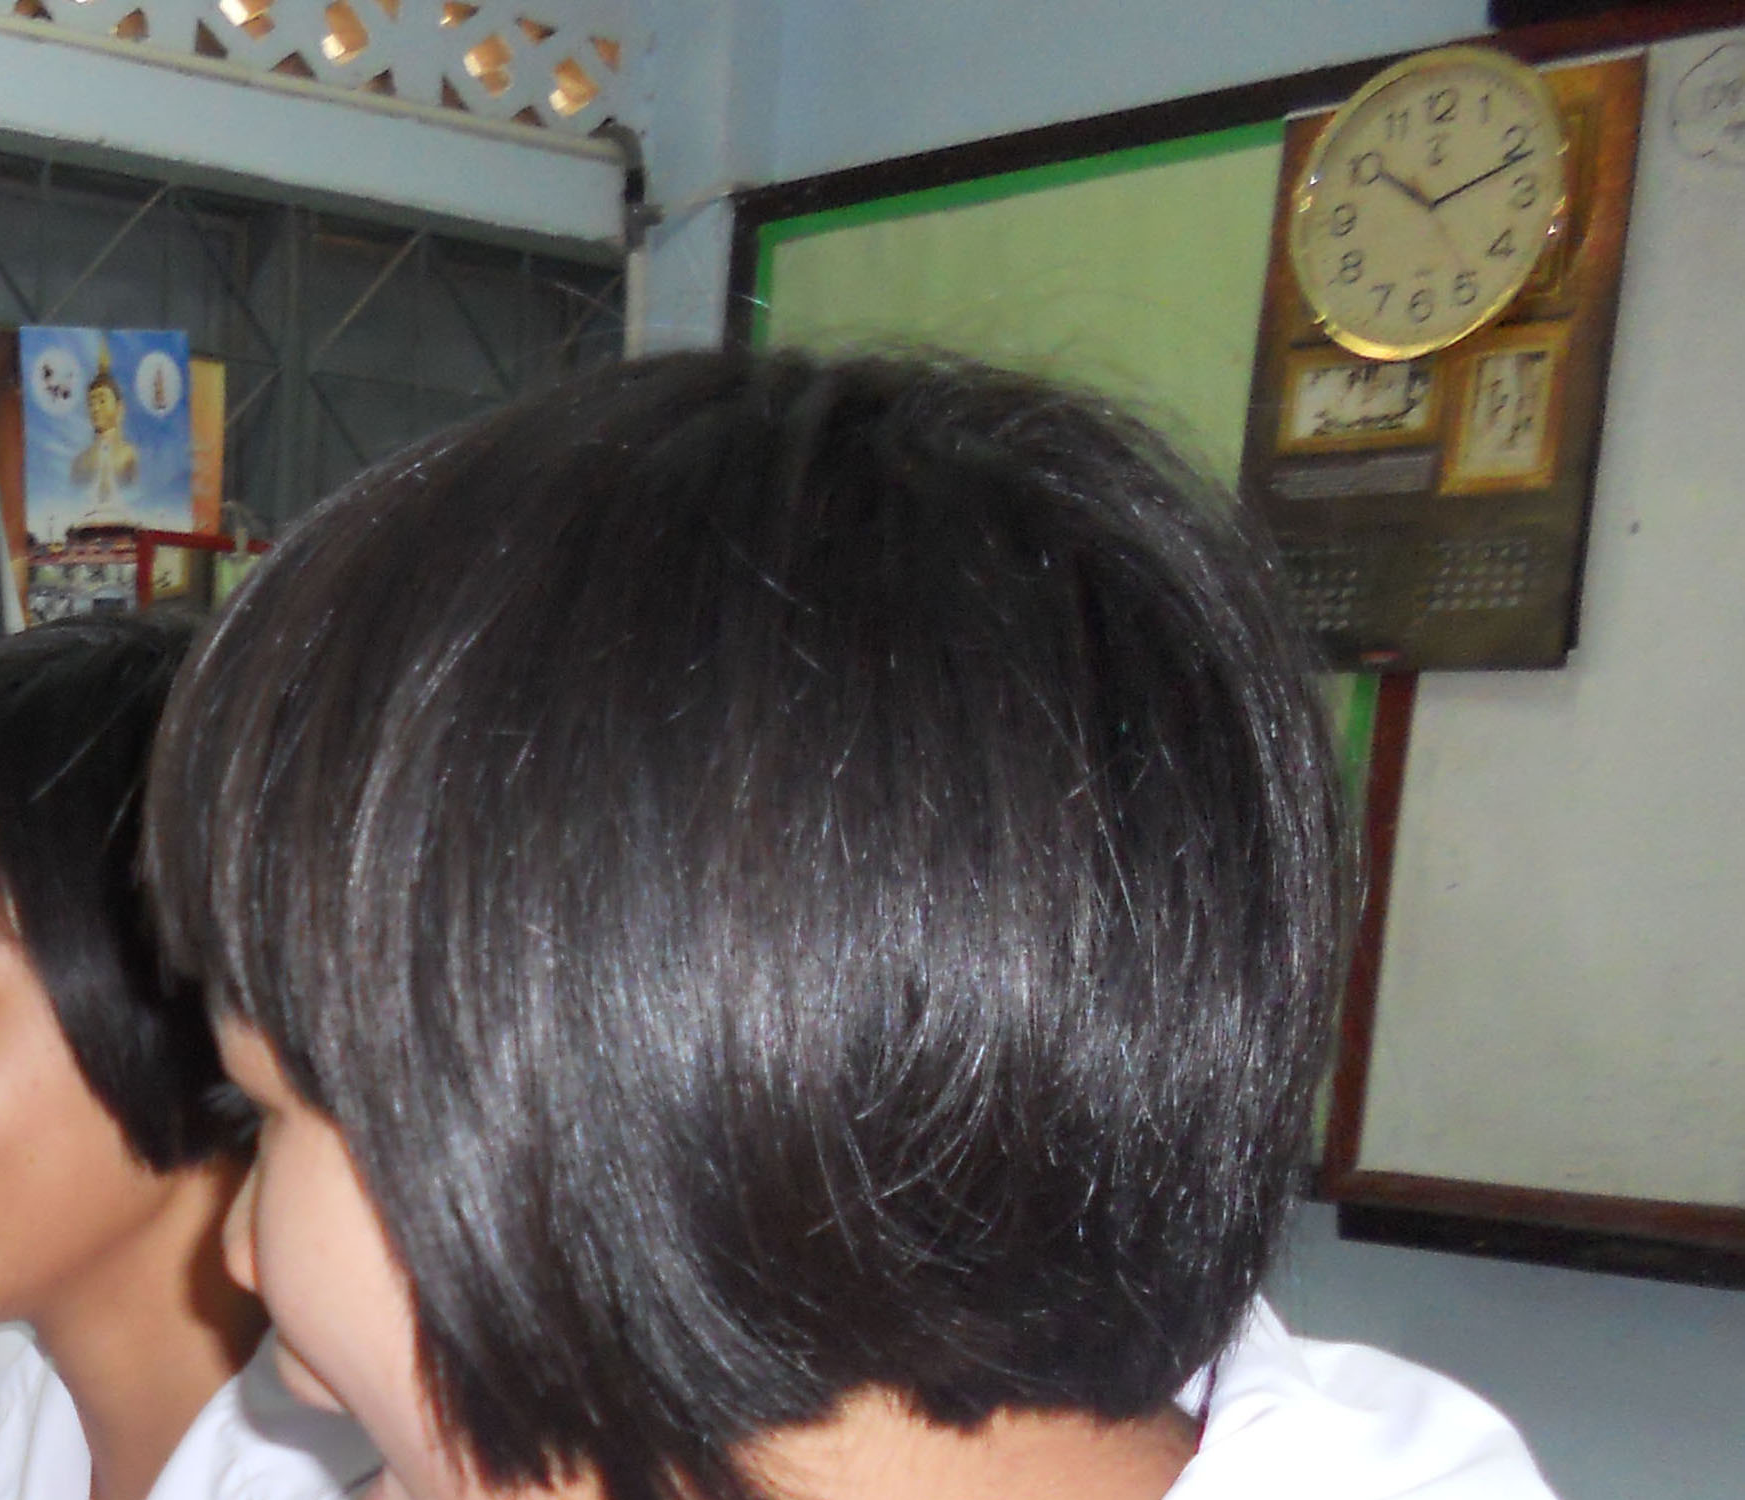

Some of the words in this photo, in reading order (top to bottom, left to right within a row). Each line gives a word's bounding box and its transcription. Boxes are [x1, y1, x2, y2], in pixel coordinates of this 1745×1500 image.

[1426, 88, 1456, 123] 12
[1479, 93, 1490, 124] 1
[1385, 111, 1408, 140] 11
[1503, 125, 1528, 161] 2
[1350, 151, 1382, 187] 10
[1512, 174, 1535, 209] 3
[1331, 204, 1357, 236] 9
[1486, 230, 1515, 258] 4
[1338, 250, 1362, 284] 8
[1369, 283, 1395, 312] 7
[1455, 271, 1477, 306] 5
[1409, 289, 1433, 323] 6
